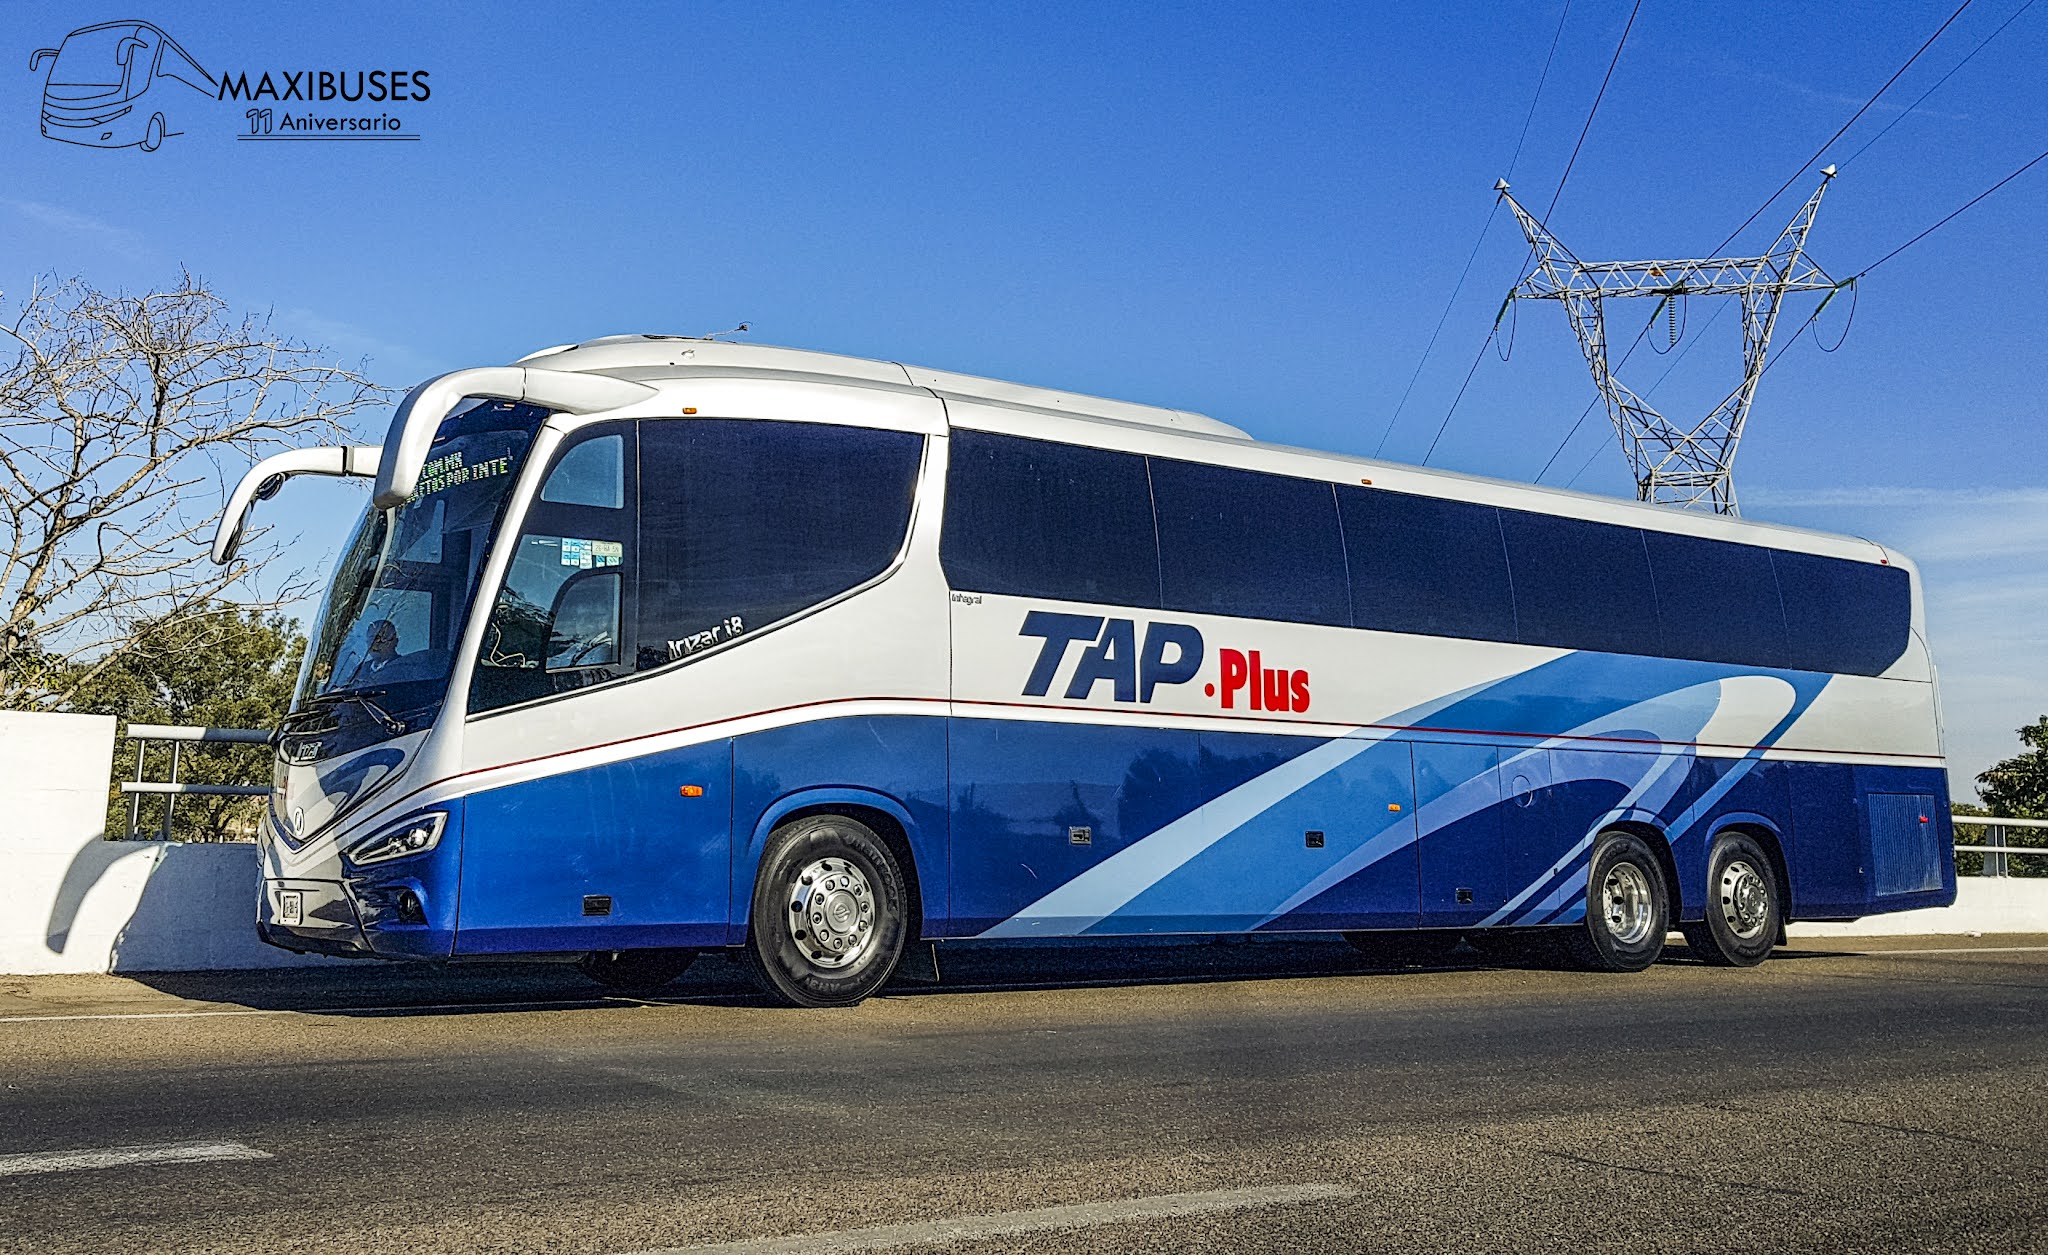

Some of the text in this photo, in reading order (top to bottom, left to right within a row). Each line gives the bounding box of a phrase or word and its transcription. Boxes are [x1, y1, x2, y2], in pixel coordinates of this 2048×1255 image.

[446, 467, 470, 488] POR
[667, 615, 744, 661] Irizar i8
[1018, 610, 1205, 704] TAP
